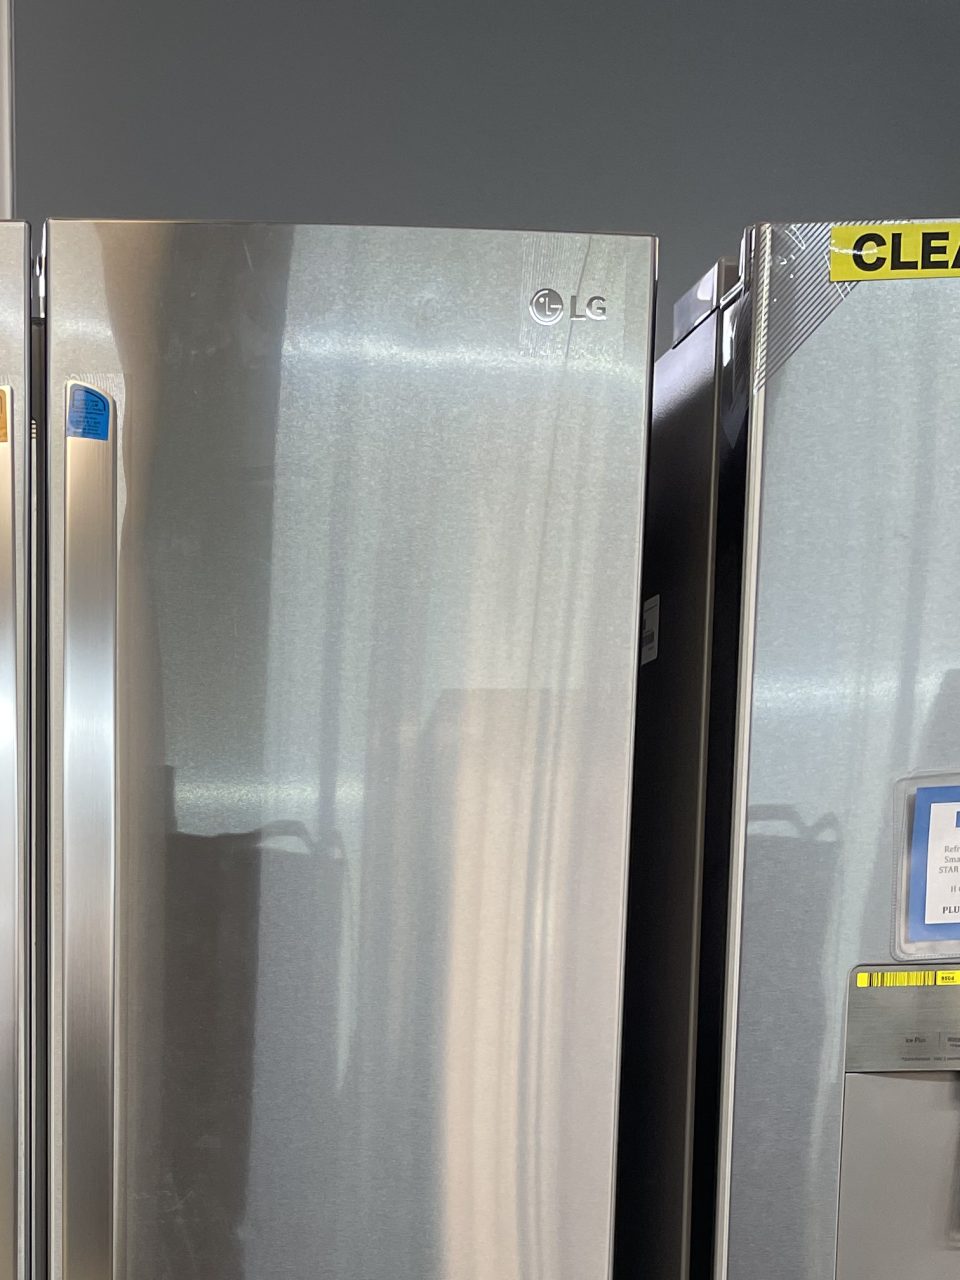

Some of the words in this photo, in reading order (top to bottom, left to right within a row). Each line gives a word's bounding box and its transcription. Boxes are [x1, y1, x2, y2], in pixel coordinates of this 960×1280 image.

[852, 231, 960, 272] CLE
[570, 295, 607, 320] LG
[938, 866, 959, 874] STAR
